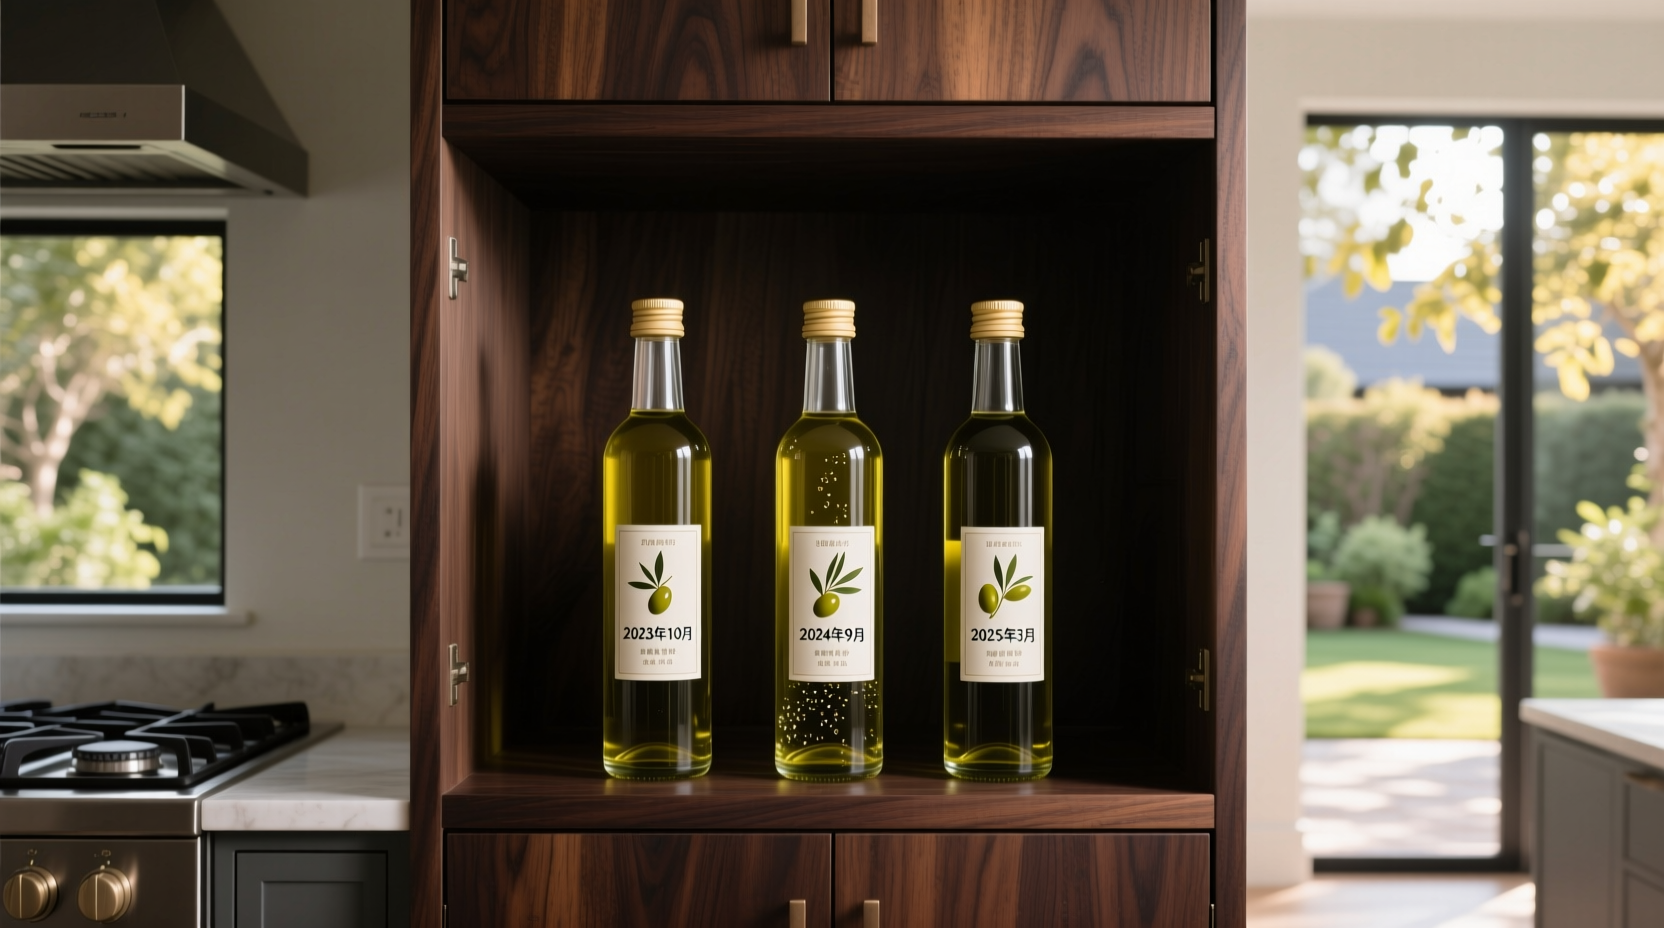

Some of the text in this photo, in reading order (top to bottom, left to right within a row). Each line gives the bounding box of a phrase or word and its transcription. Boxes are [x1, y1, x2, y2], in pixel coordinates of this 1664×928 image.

[623, 626, 692, 641] 2023年10月
[799, 627, 864, 642] 2024年9月
[971, 627, 1035, 643] 2025年3月
